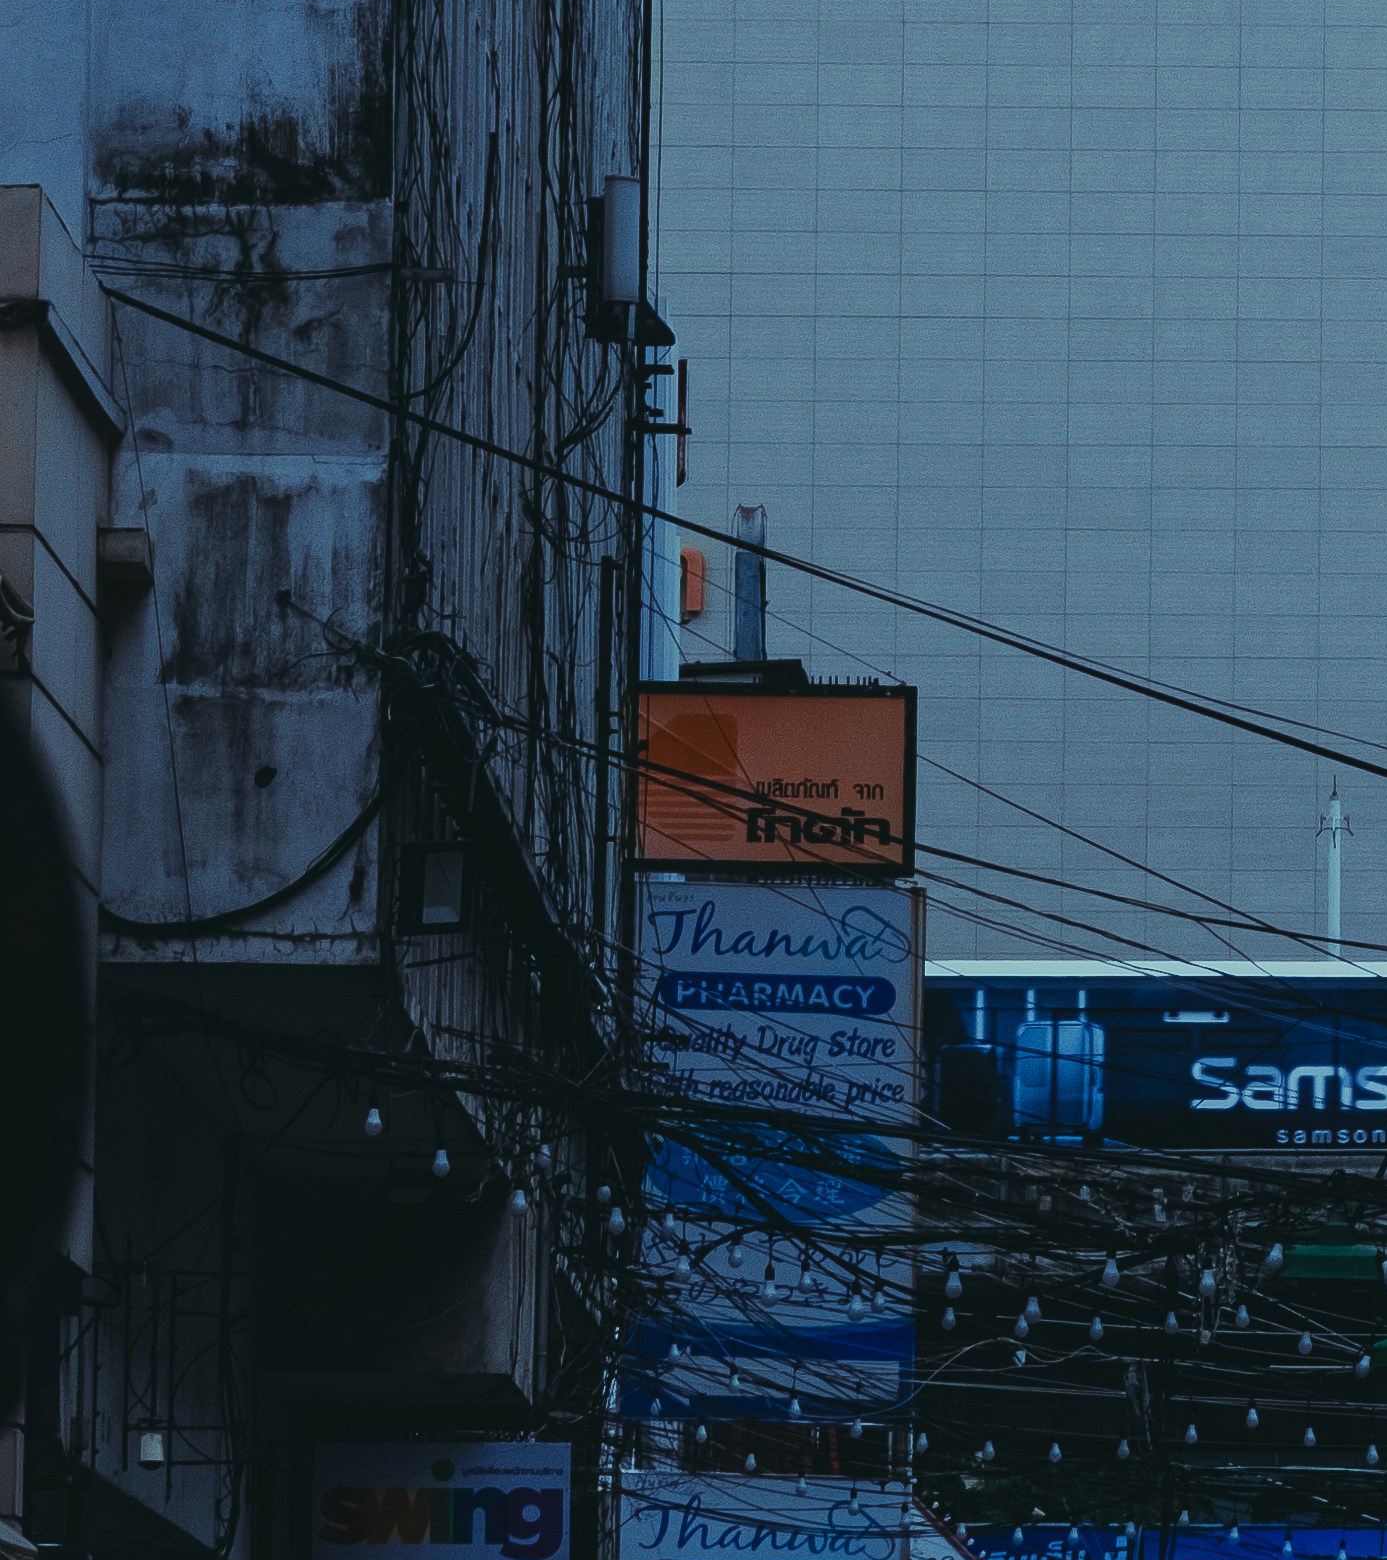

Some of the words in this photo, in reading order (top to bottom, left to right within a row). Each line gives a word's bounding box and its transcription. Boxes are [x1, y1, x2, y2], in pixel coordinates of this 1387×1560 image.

[853, 783, 885, 800] จาก
[648, 900, 884, 960] Thanwa
[676, 978, 876, 1009] PHARMACY
[757, 1025, 821, 1064] Drug
[828, 1026, 897, 1058] Store
[708, 1069, 837, 1103] reasonable
[850, 1077, 905, 1113] price
[317, 1458, 564, 1560] swing
[637, 1493, 868, 1555] Thanwa
